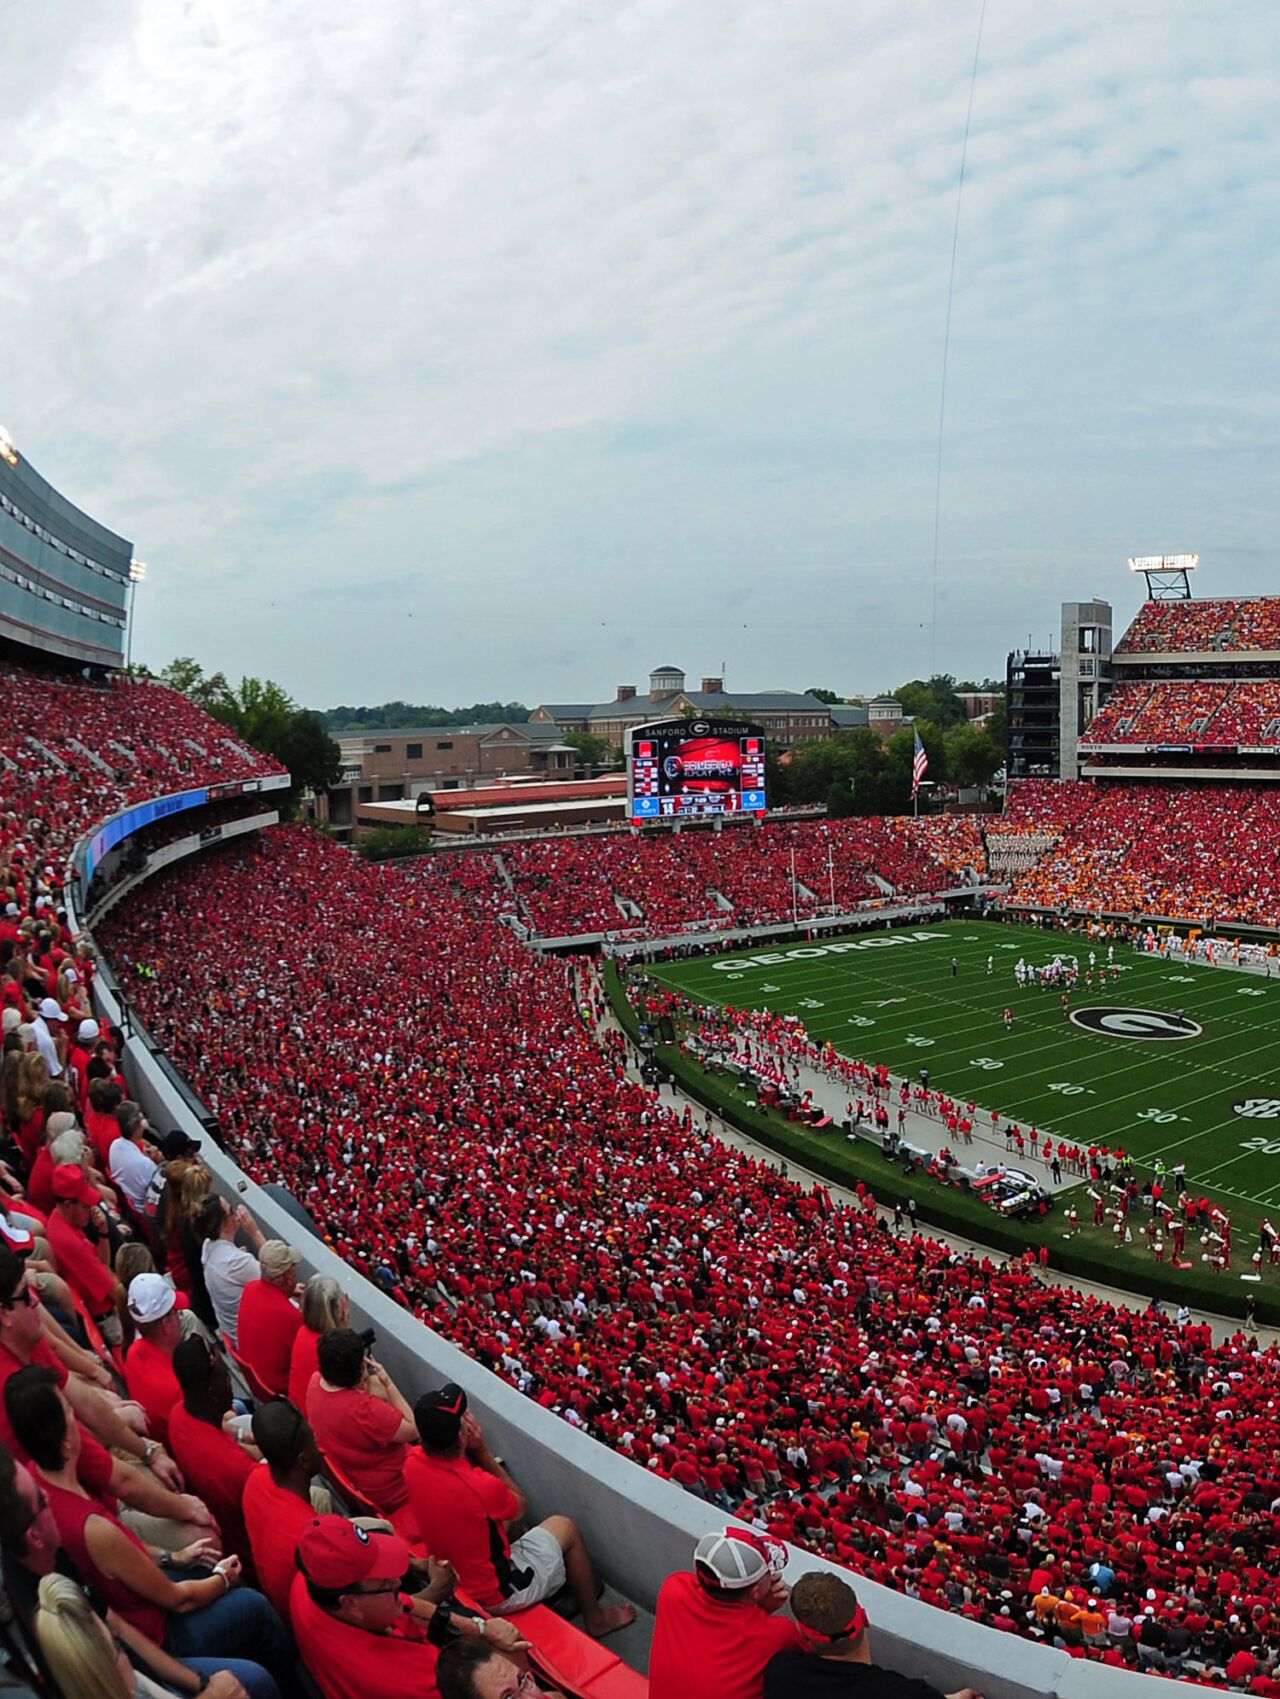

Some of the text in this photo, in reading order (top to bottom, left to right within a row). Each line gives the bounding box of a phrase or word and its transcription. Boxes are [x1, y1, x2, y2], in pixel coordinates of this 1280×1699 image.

[645, 728, 686, 737] SANFORD
[712, 727, 749, 735] STADIUM
[711, 931, 952, 970] GEORGIA
[848, 1016, 876, 1027] 30
[1099, 1013, 1201, 1036] G
[905, 1034, 936, 1047] 40
[969, 1057, 1004, 1070] 50
[1047, 1082, 1085, 1095] 40
[1136, 1108, 1178, 1123] 30
